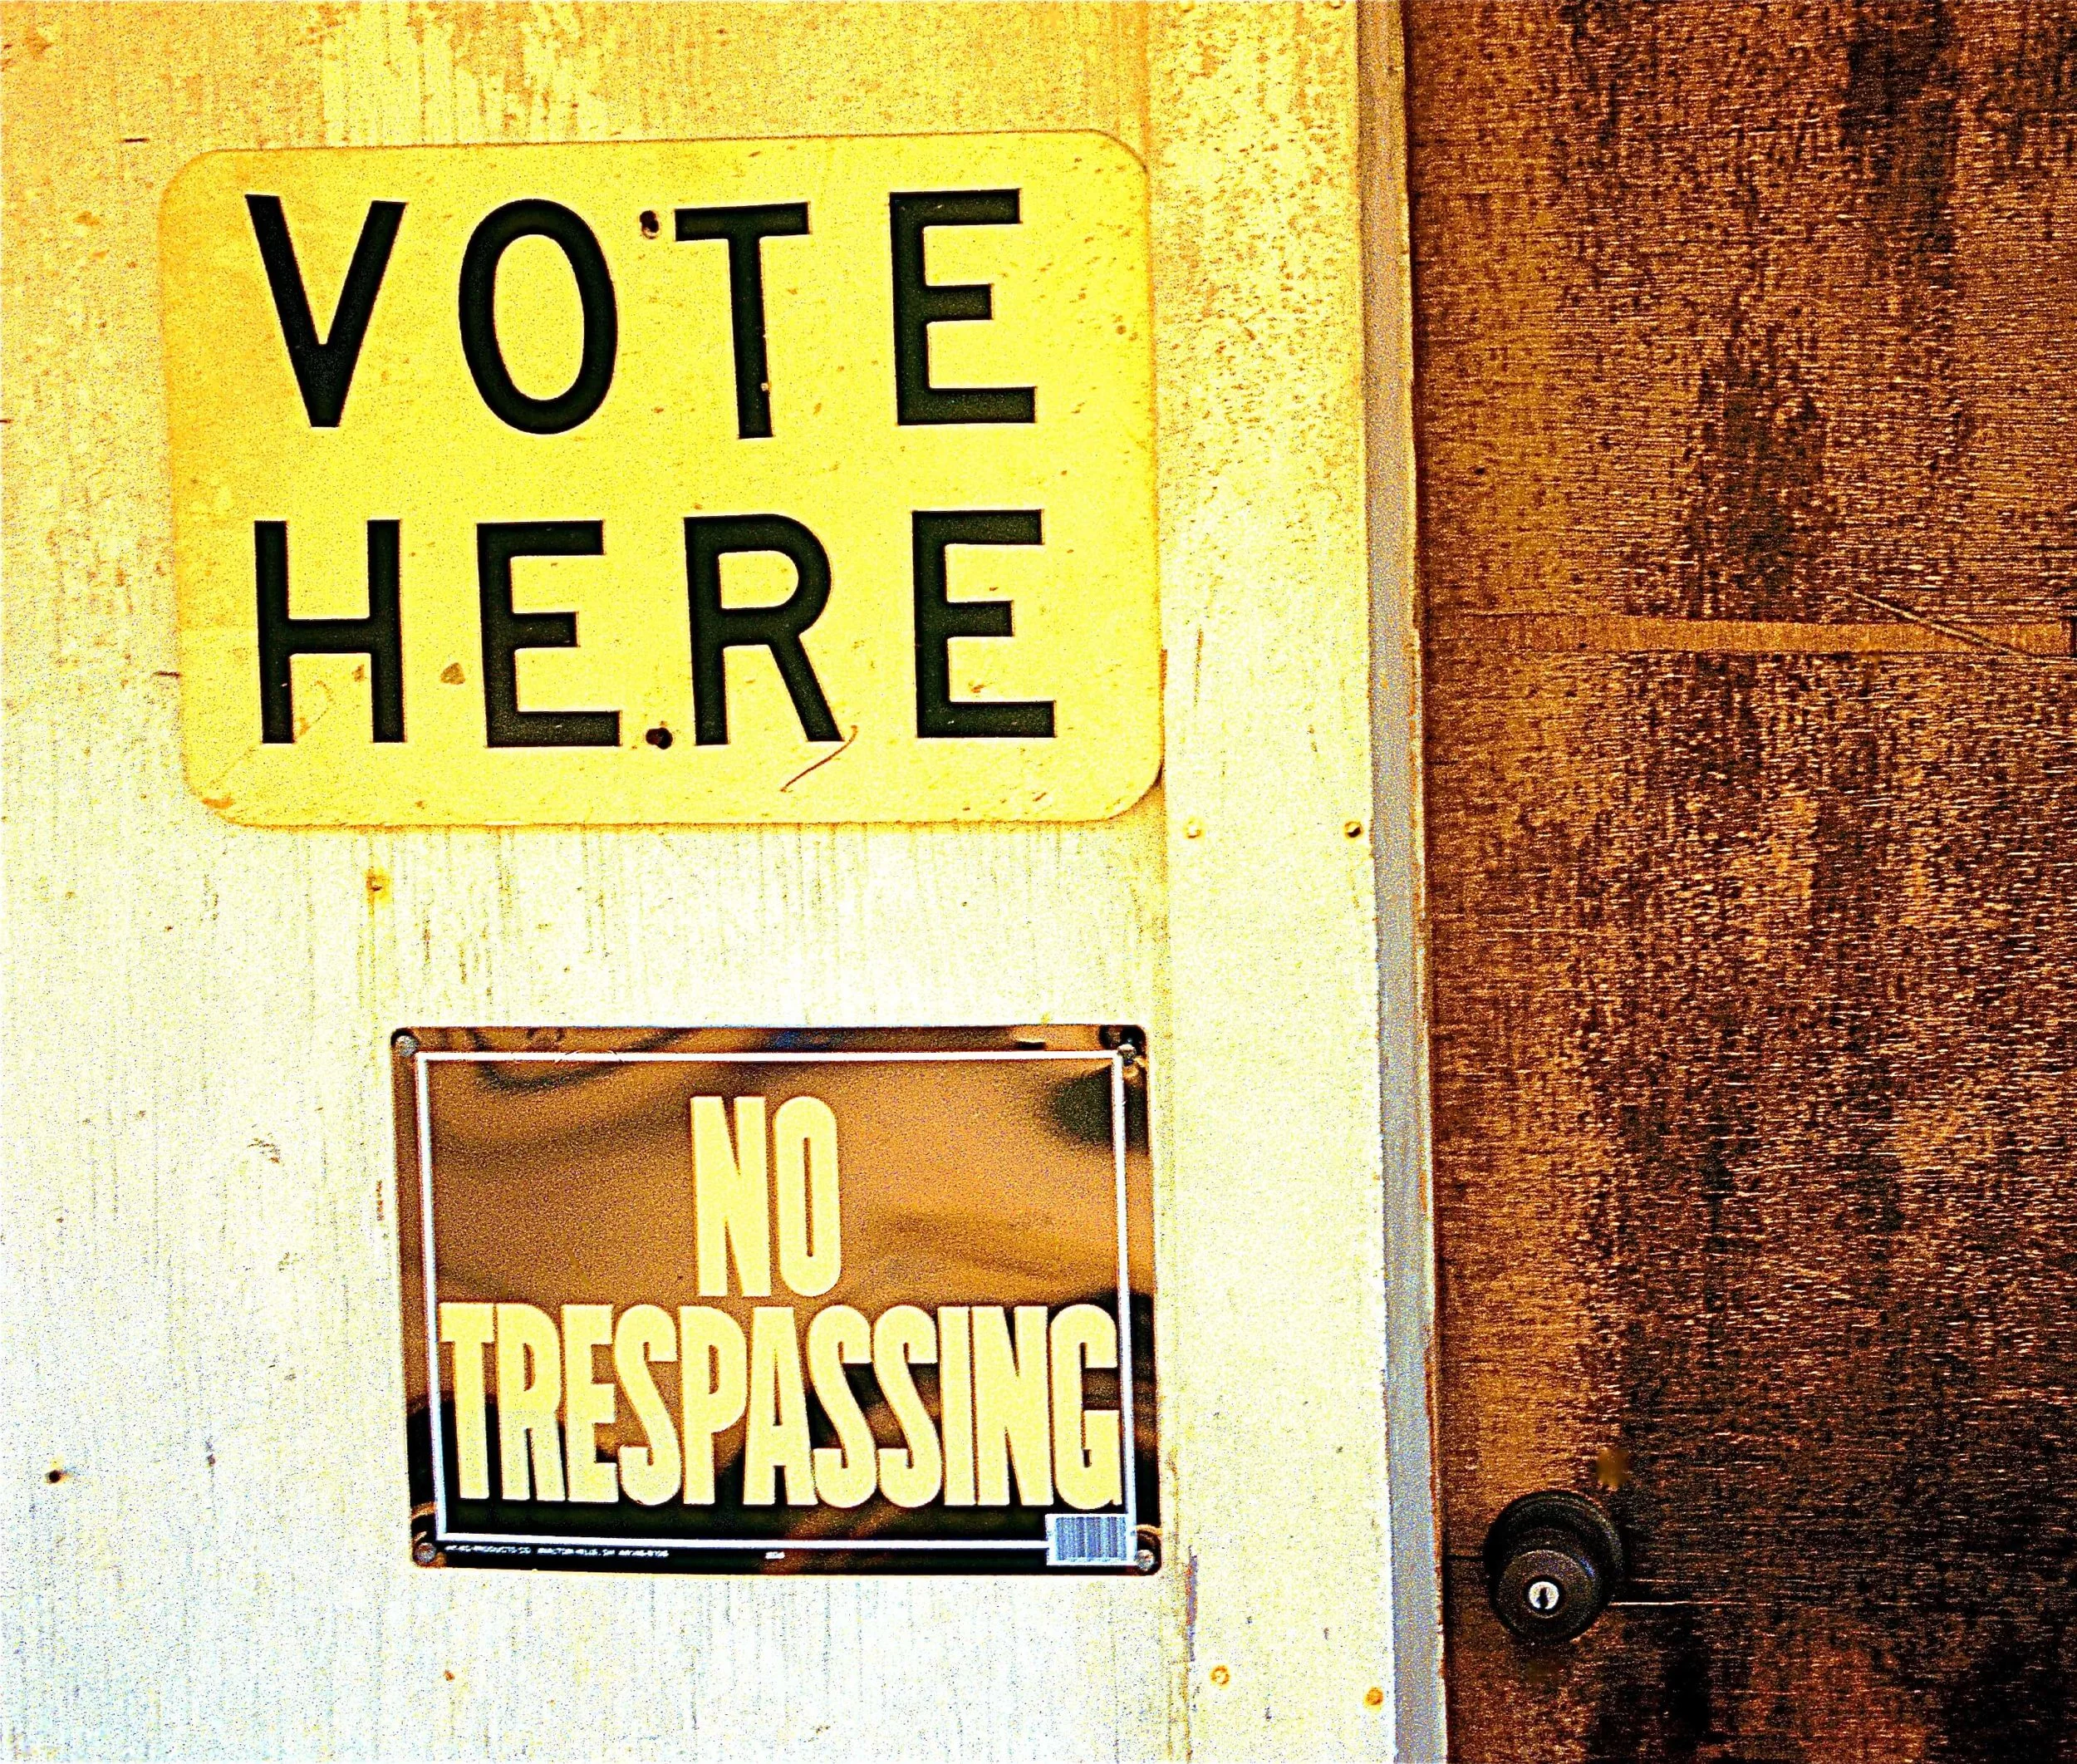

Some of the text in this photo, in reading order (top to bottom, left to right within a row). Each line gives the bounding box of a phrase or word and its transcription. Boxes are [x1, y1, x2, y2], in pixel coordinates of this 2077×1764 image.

[244, 189, 1035, 438] VOTE
[256, 509, 1055, 748] HERE
[690, 1095, 842, 1299] NO
[439, 1302, 1122, 1511] TRESPASSING
